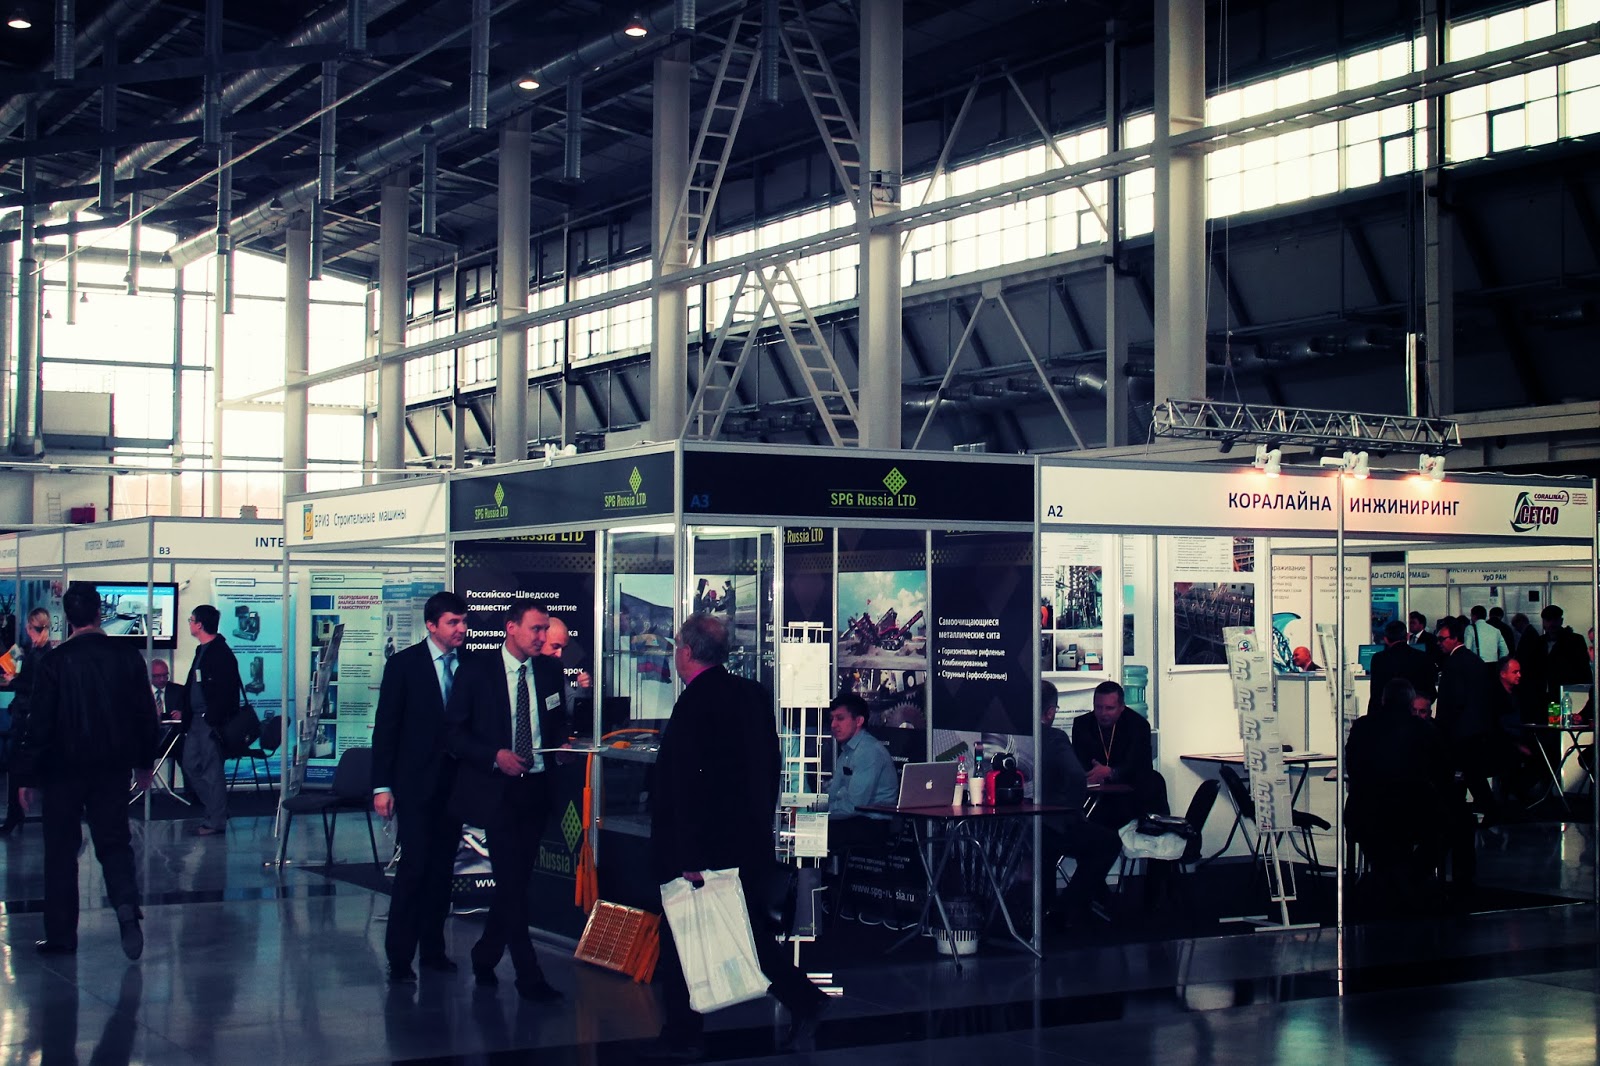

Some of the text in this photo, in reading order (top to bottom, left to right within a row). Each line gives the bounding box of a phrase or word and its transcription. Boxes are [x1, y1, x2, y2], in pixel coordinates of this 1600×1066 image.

[604, 492, 647, 508] SPG Russia LTD
[690, 494, 710, 509] A3
[831, 492, 916, 507] SPG Russia LTD
[1228, 490, 1460, 516] КОРАЛАЙНА ИНЖИНИРИНГ
[314, 508, 407, 528] БРИЗ Строительные машины
[474, 505, 509, 520] SPG Russia LTD
[1047, 505, 1064, 518] A2
[1520, 505, 1559, 525] CETCO
[787, 528, 824, 544] Russia LTD
[159, 546, 171, 555] B3
[1380, 570, 1430, 579] «СТРОЙДРМАШ»
[466, 590, 560, 600] Российско-Шведское
[938, 616, 999, 628] Самоочищающиеся
[938, 631, 1001, 640] металлические сита
[942, 647, 1005, 657] Горизонтально рифленые
[942, 658, 988, 668] Комбинированные
[942, 669, 965, 680] Струнные
[540, 845, 570, 873] Russia
